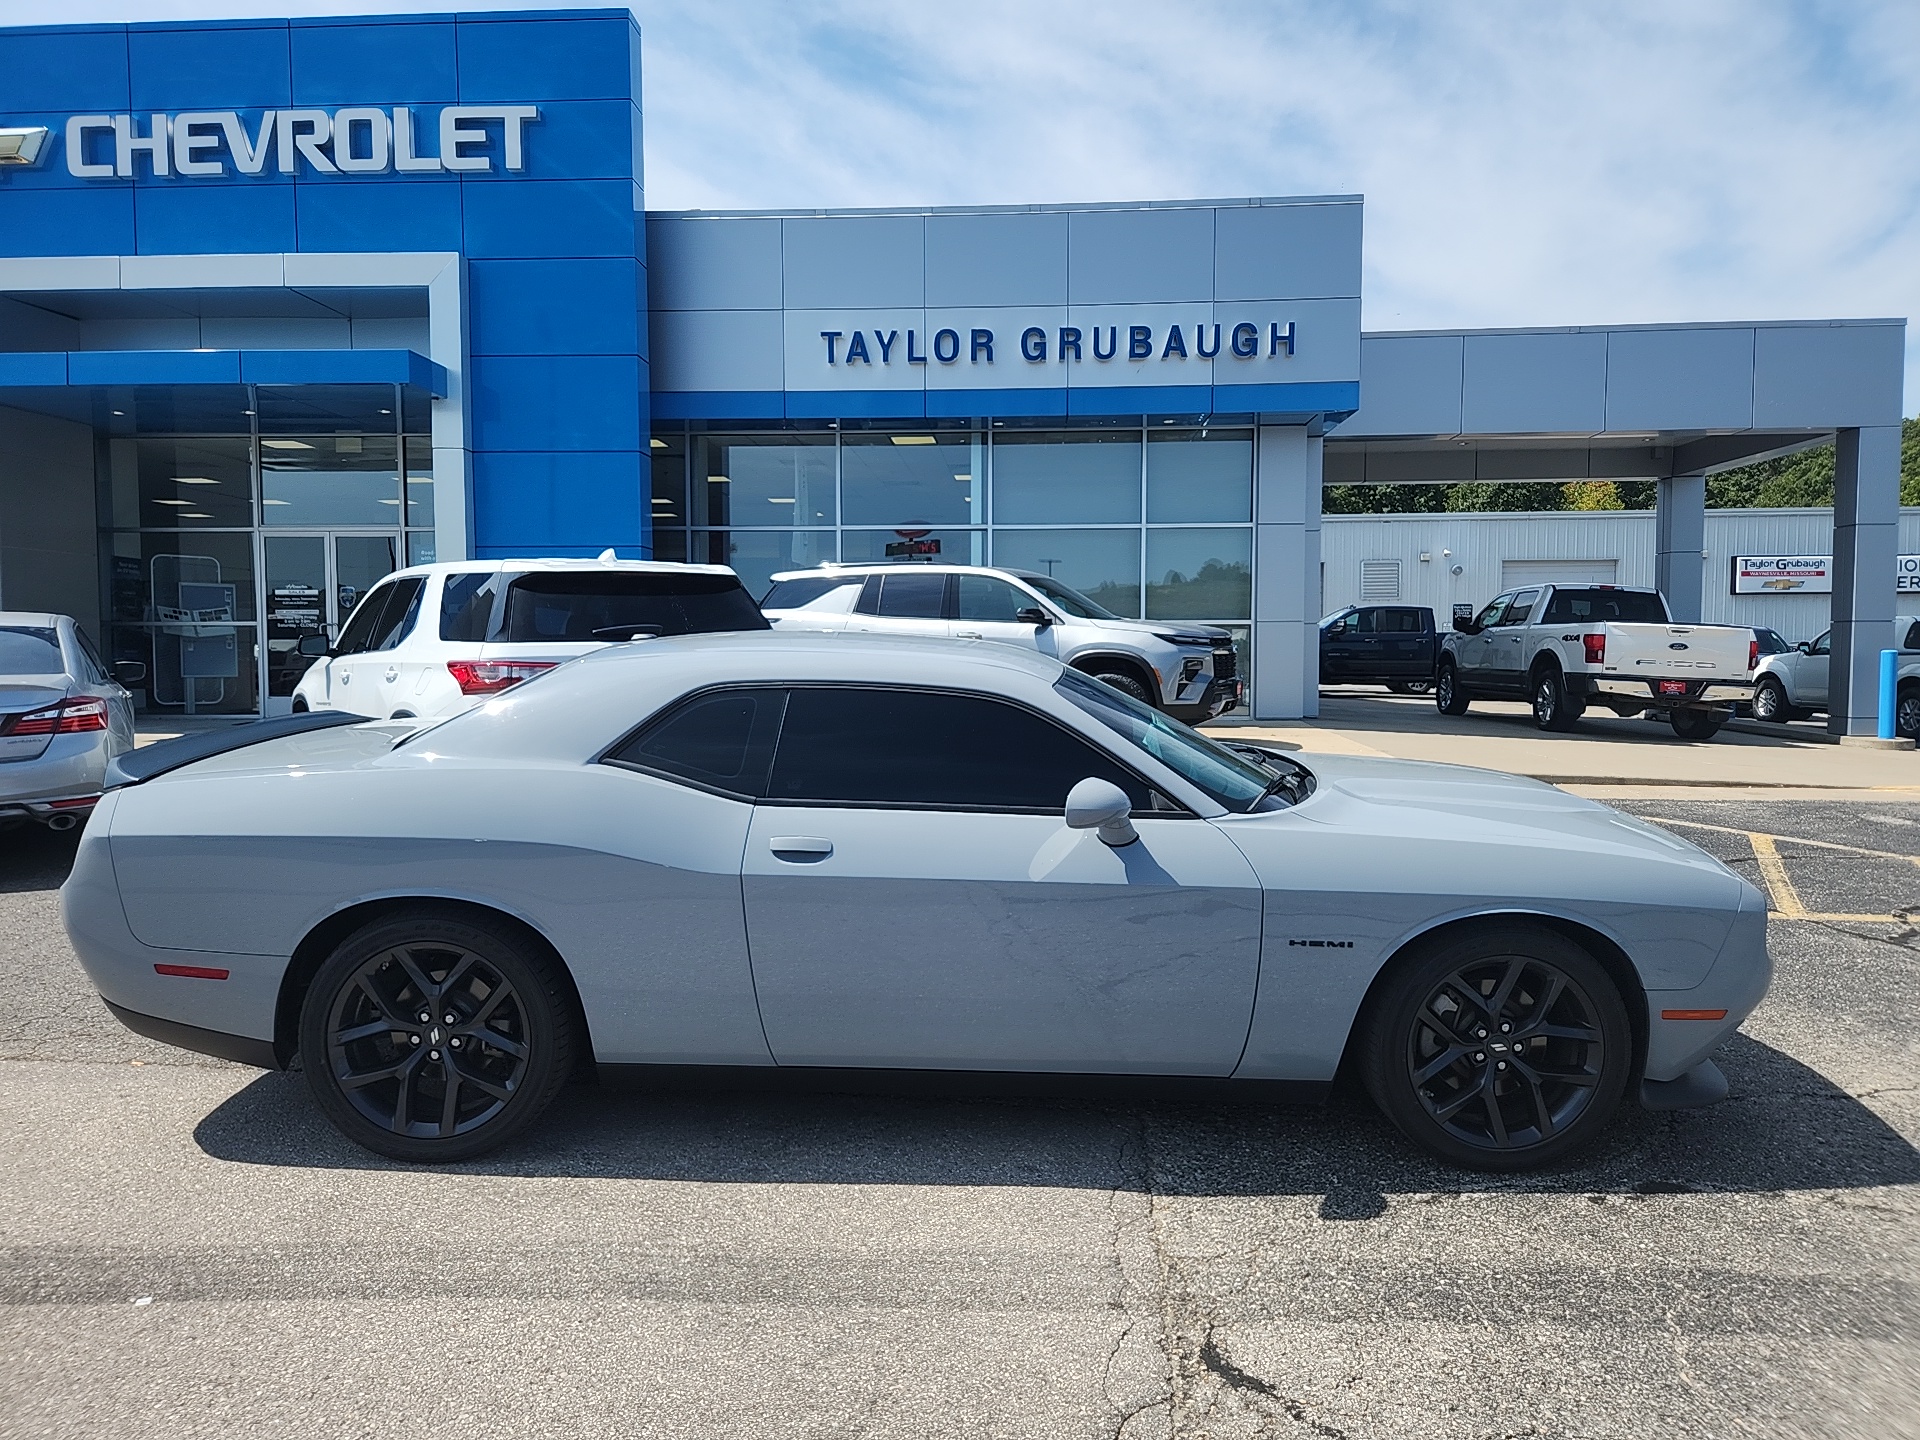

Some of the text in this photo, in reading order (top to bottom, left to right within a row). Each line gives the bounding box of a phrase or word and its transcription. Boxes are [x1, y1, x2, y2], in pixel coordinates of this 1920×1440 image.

[66, 105, 542, 178] CHEVROLET
[820, 321, 1296, 364] TAYLOR GRUBAUGH
[1741, 559, 1825, 570] Taylor Grubaugh
[1899, 559, 1920, 572] IO
[1289, 940, 1353, 948] HEMI
